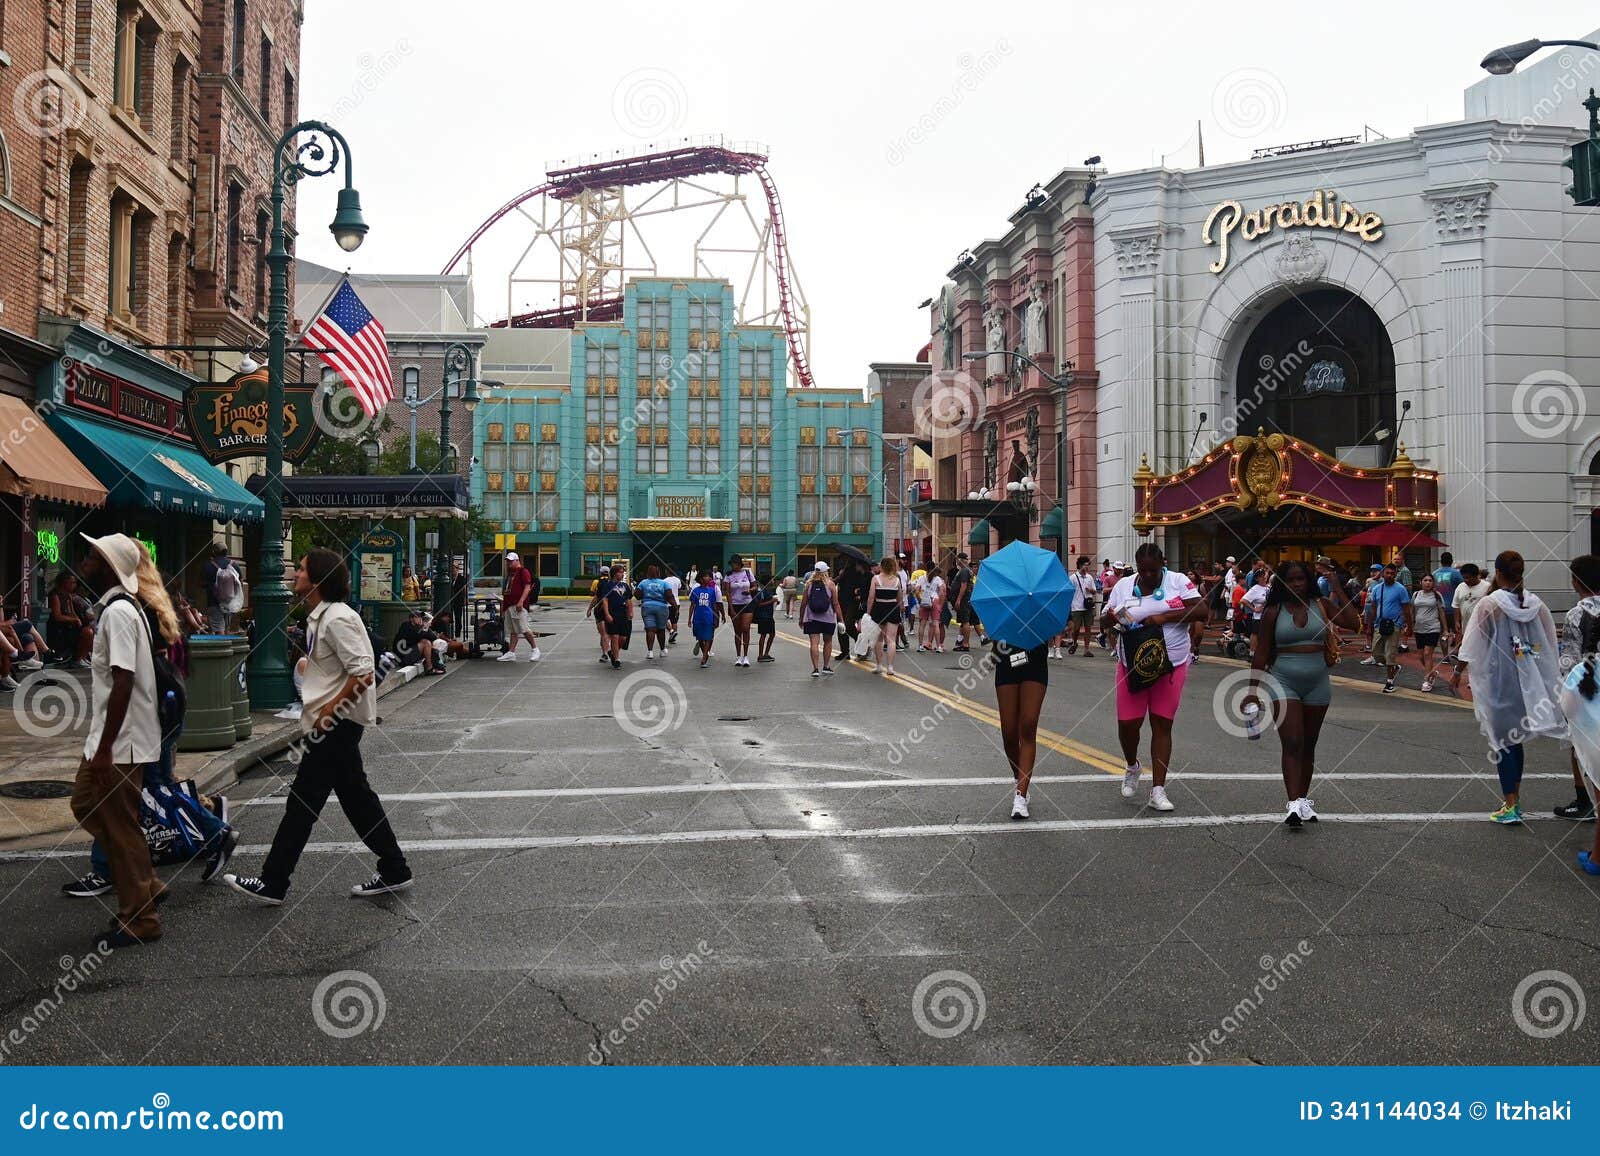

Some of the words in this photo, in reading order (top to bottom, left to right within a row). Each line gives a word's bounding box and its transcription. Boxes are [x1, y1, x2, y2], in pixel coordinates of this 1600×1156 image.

[1202, 189, 1385, 274] Paradise
[298, 494, 349, 505] PRISCILLA
[352, 494, 387, 505] HOTEL
